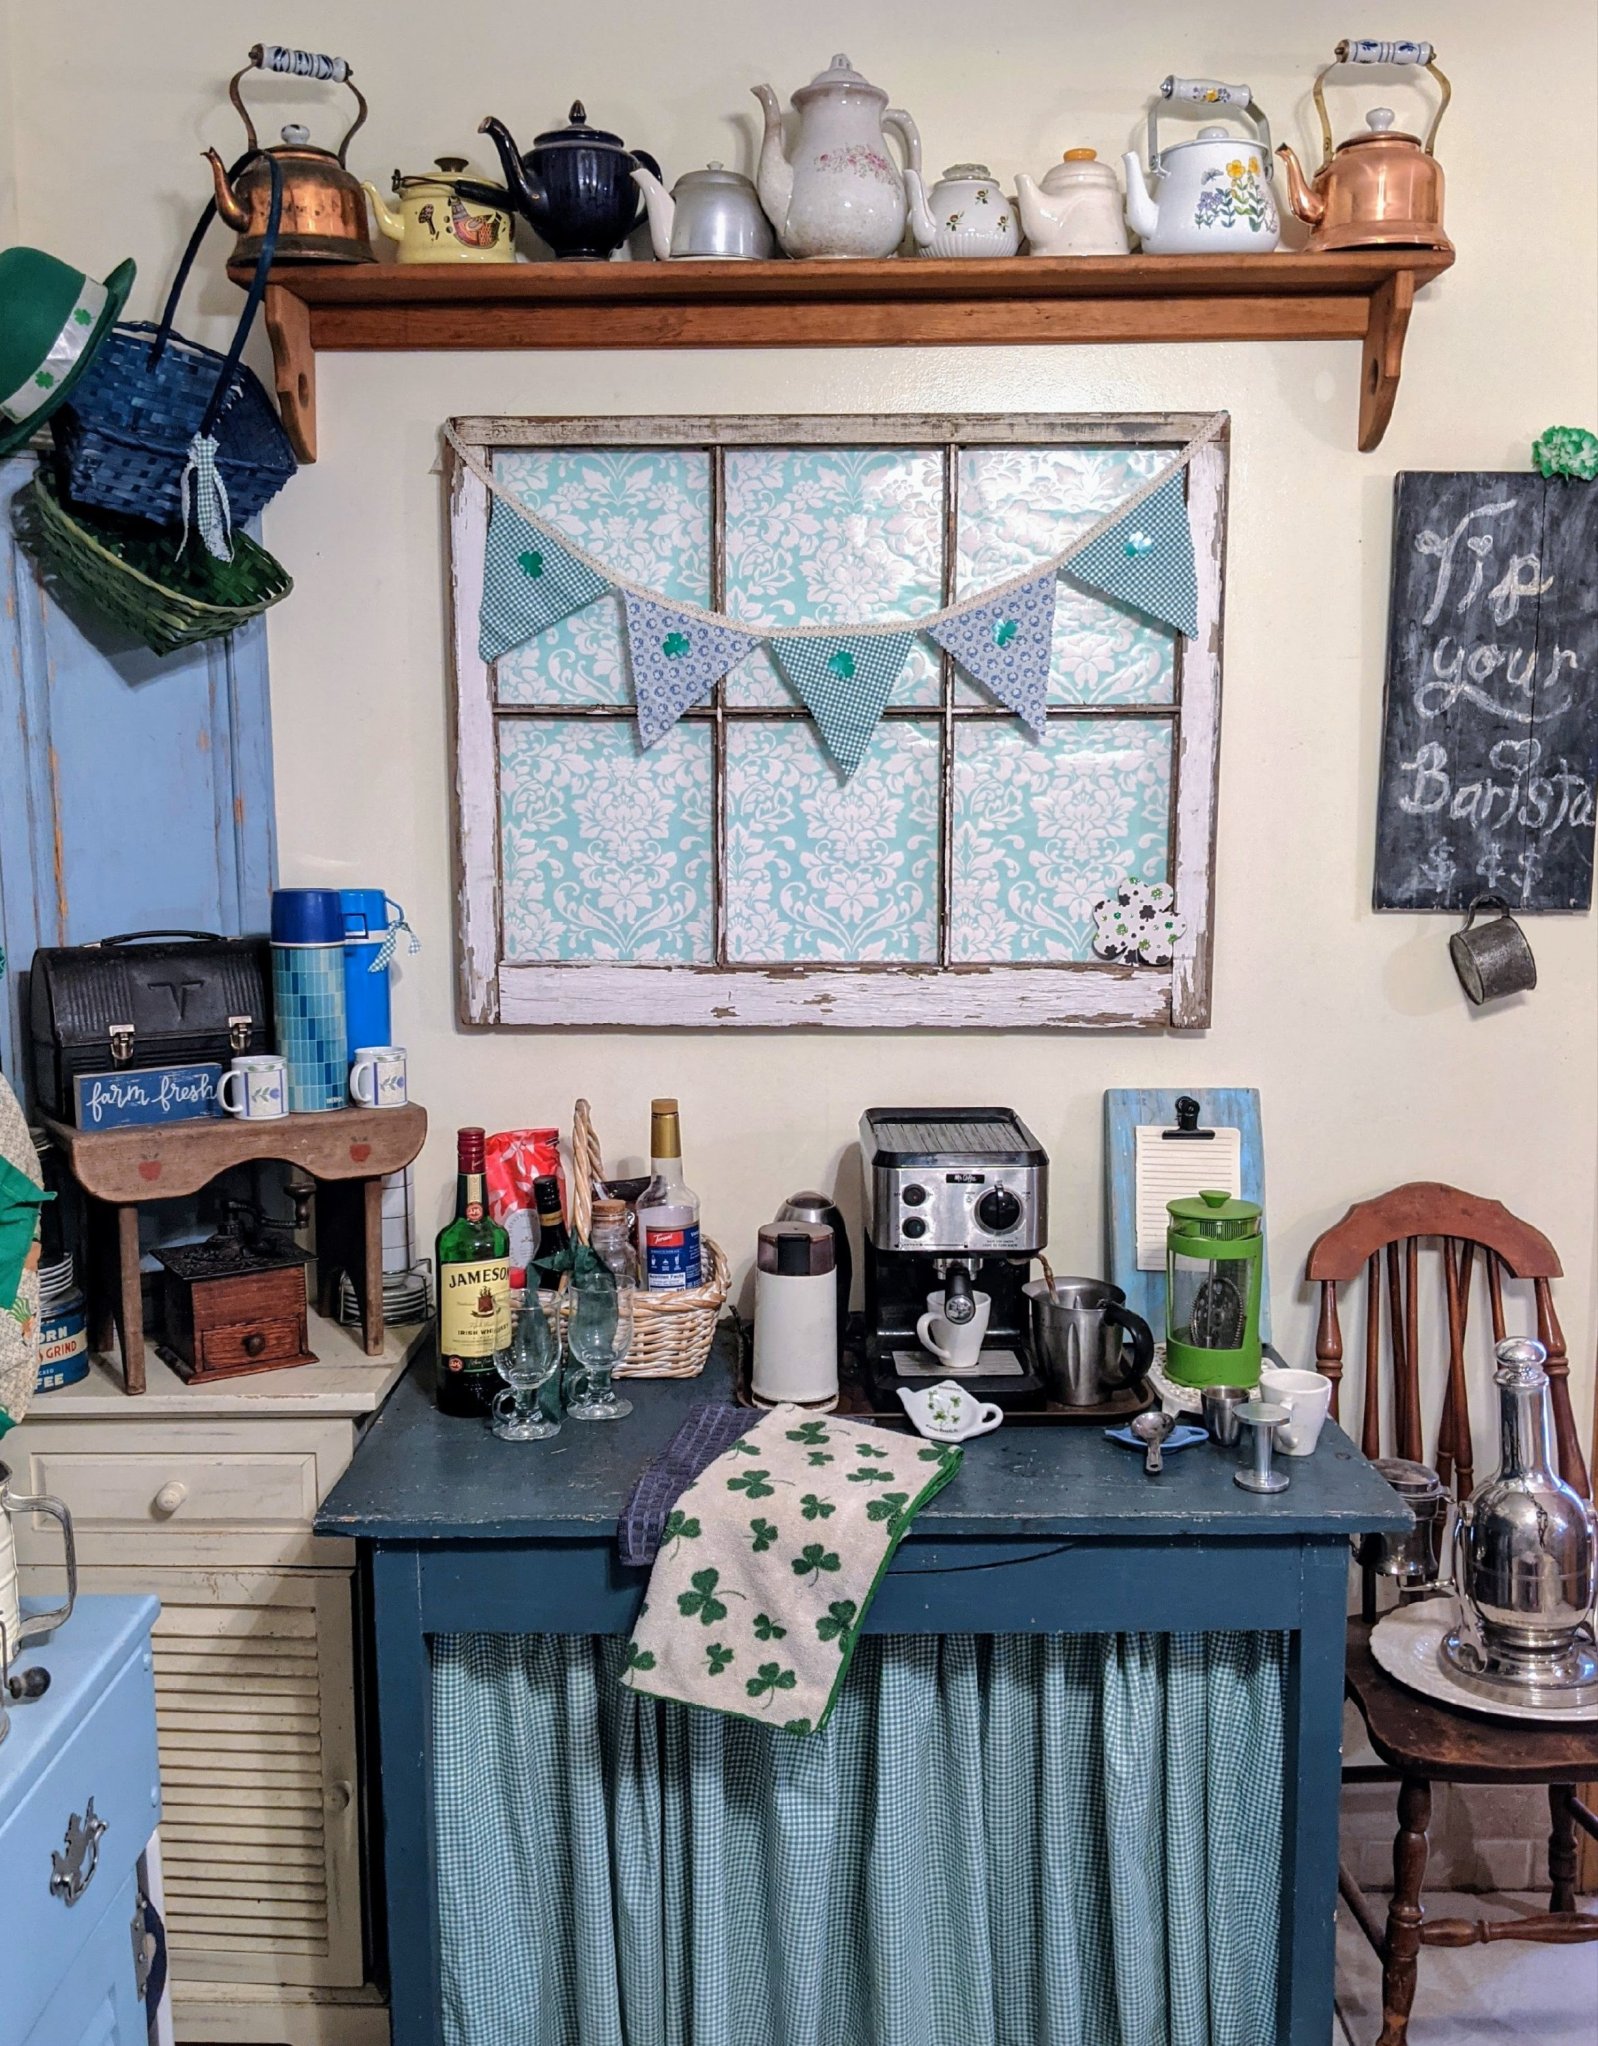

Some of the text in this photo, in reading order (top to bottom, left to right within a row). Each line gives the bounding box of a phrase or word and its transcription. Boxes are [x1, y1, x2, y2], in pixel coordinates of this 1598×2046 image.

[1414, 499, 1554, 626] Tip
[1413, 636, 1578, 723] your
[1399, 738, 1596, 837] Barista
[86, 1073, 218, 1123] farm fresh
[45, 1340, 77, 1359] GRIND
